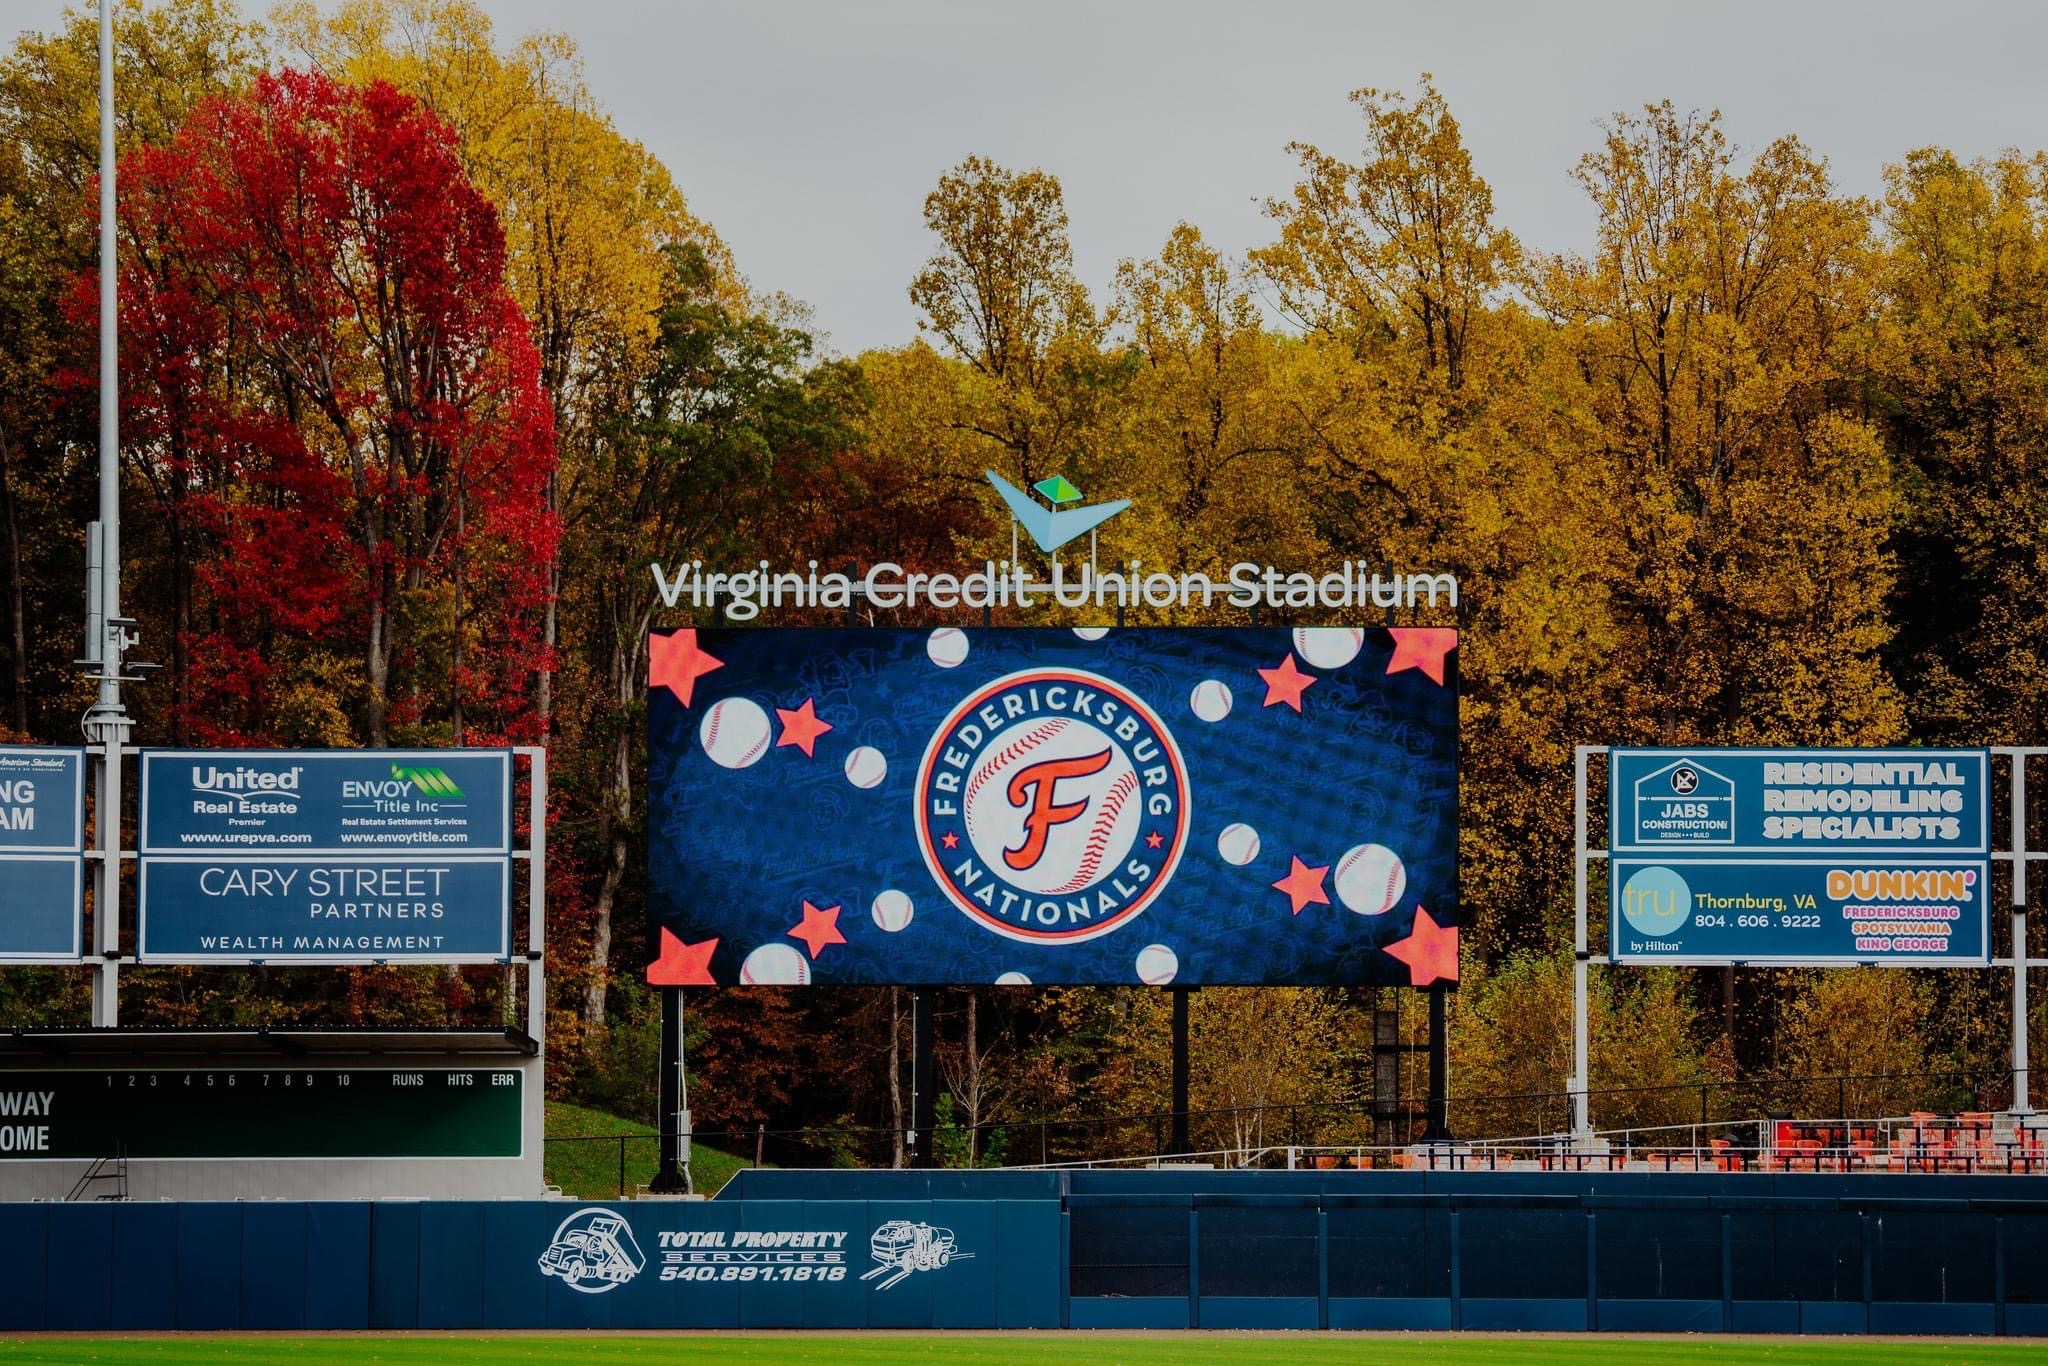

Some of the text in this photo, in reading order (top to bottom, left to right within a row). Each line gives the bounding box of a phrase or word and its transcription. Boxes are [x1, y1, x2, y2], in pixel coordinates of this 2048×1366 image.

[651, 559, 1459, 620] Virginia Credit Union Stadium
[934, 687, 1172, 817] FREDERICKSBURG
[192, 766, 299, 789] United
[1763, 762, 1966, 785] RESIDENTIAL
[342, 780, 413, 798] ENVOY
[193, 800, 298, 814] Real Estate
[374, 799, 439, 813] Title Inc
[1002, 746, 1113, 871] F
[1763, 789, 1964, 813] REMODELING
[1660, 803, 1710, 819] JABS
[228, 818, 266, 826] Premier
[342, 817, 468, 826] Real Estate Settlement Services
[1642, 820, 1724, 830] CONSTRUCTION
[1762, 816, 1961, 840] SPECIALISTS
[180, 833, 312, 845] www.urepva.com
[341, 831, 468, 845] www.envoytitle.com
[200, 867, 450, 897] CARY STREET
[954, 858, 1151, 925] NATIONALS
[1625, 883, 1676, 917] tru
[1695, 893, 1817, 912] Thornburg, VA
[310, 902, 445, 919] PARTNERS
[1843, 905, 1961, 920] FREDERICKSBURG
[1695, 914, 1822, 928] 804 606 9222
[1852, 921, 1952, 936] SPOTSYLVANIA
[200, 935, 445, 950] WEALTH MANAGEMENT
[1631, 941, 1644, 953] by
[1855, 937, 1948, 951] KING GEORGE
[106, 1074, 515, 1087] 1 2 3 4 5 6 7 8 9 10 RUNS HITS ERR
[658, 1231, 848, 1248] TOTAL PROPERTY
[666, 1252, 843, 1263] SERVICES
[659, 1266, 848, 1282] 540.891.1818
